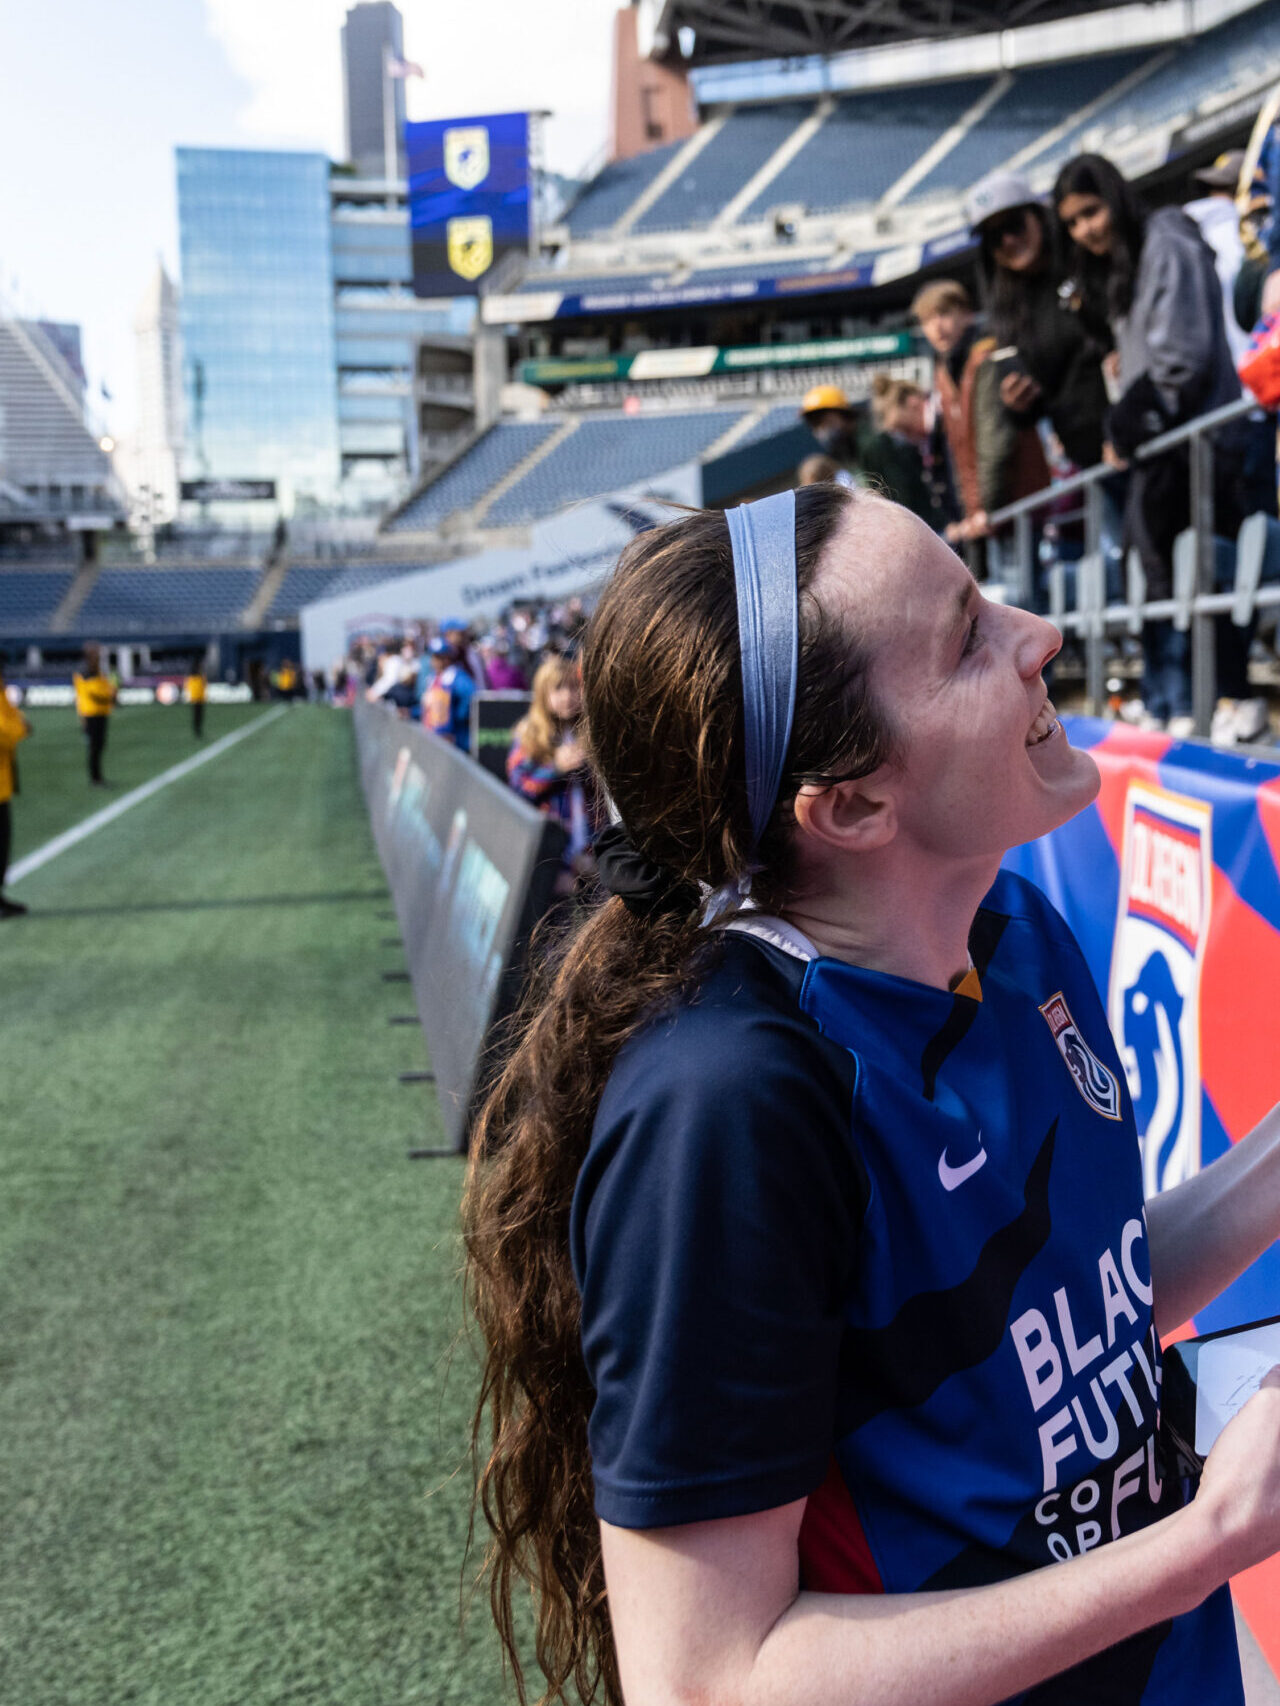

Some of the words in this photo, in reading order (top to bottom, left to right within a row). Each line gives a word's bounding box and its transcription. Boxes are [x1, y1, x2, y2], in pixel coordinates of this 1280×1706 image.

[1010, 1206, 1154, 1413] BLAC
[1034, 1478, 1100, 1526] CO
[1046, 1520, 1102, 1563] OP
